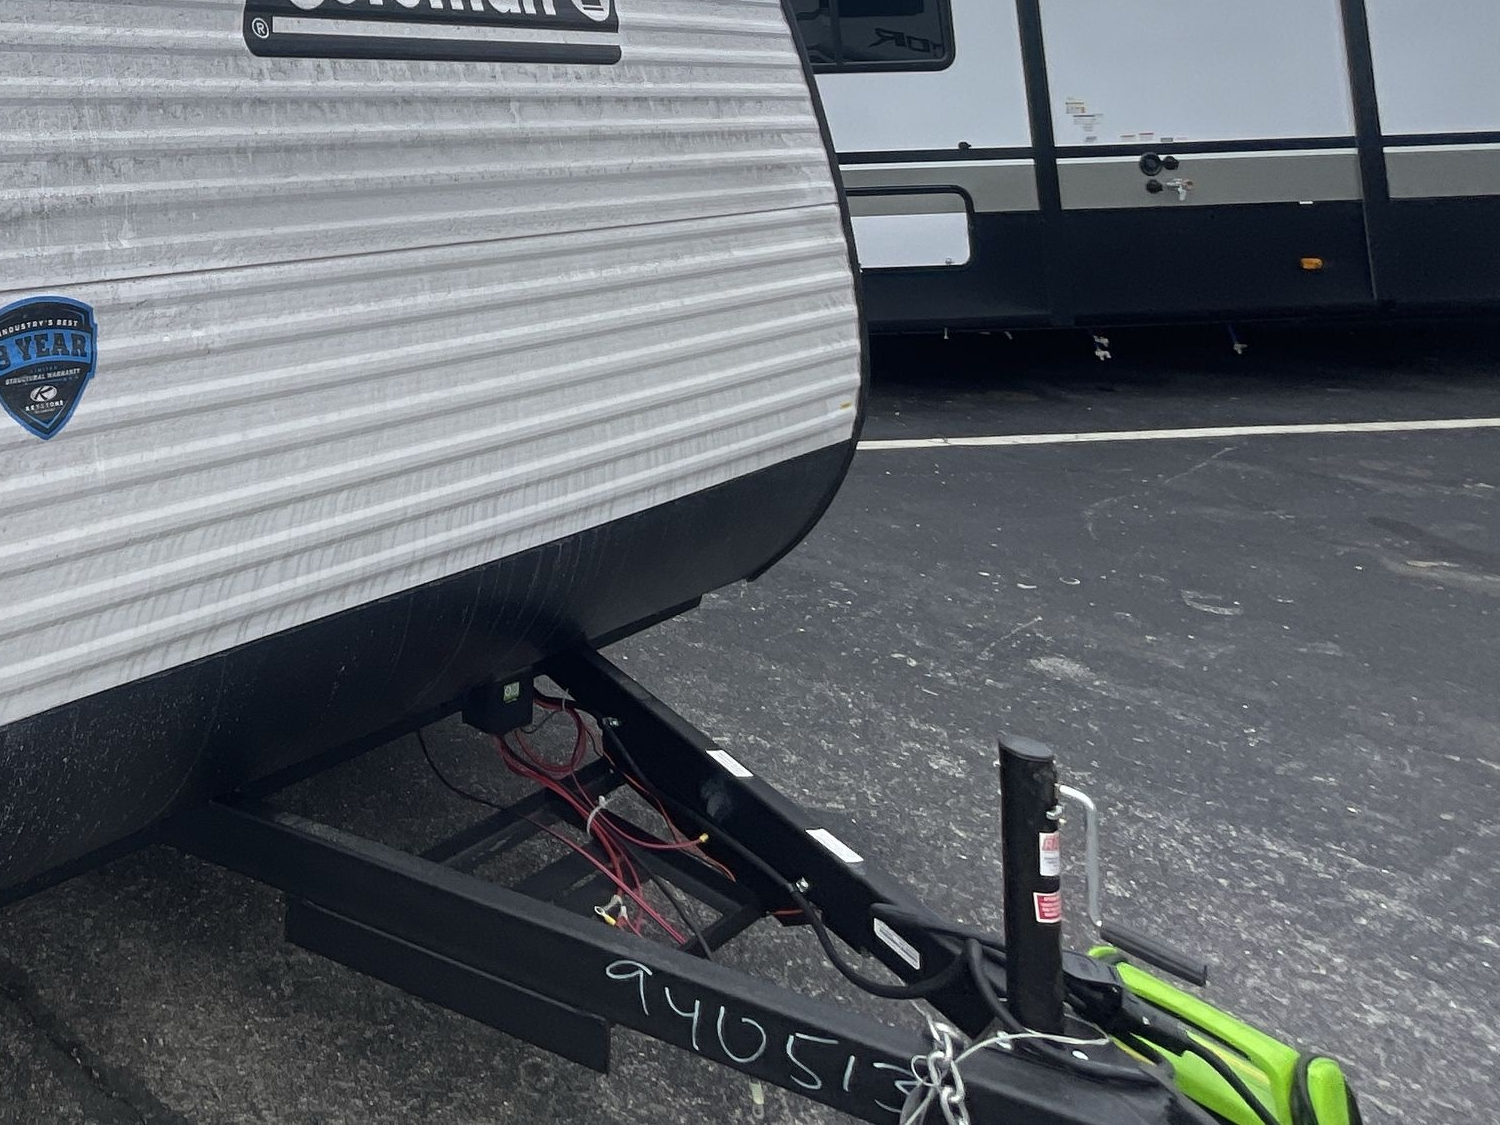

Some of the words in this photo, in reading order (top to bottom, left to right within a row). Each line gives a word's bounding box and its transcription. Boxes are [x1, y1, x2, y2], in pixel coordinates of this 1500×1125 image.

[56, 319, 79, 327] BEST
[14, 332, 88, 362] YEAR
[5, 373, 46, 385] STRUCTURAL
[46, 368, 81, 379] WARRANTY
[25, 400, 64, 412] KEYSTONE
